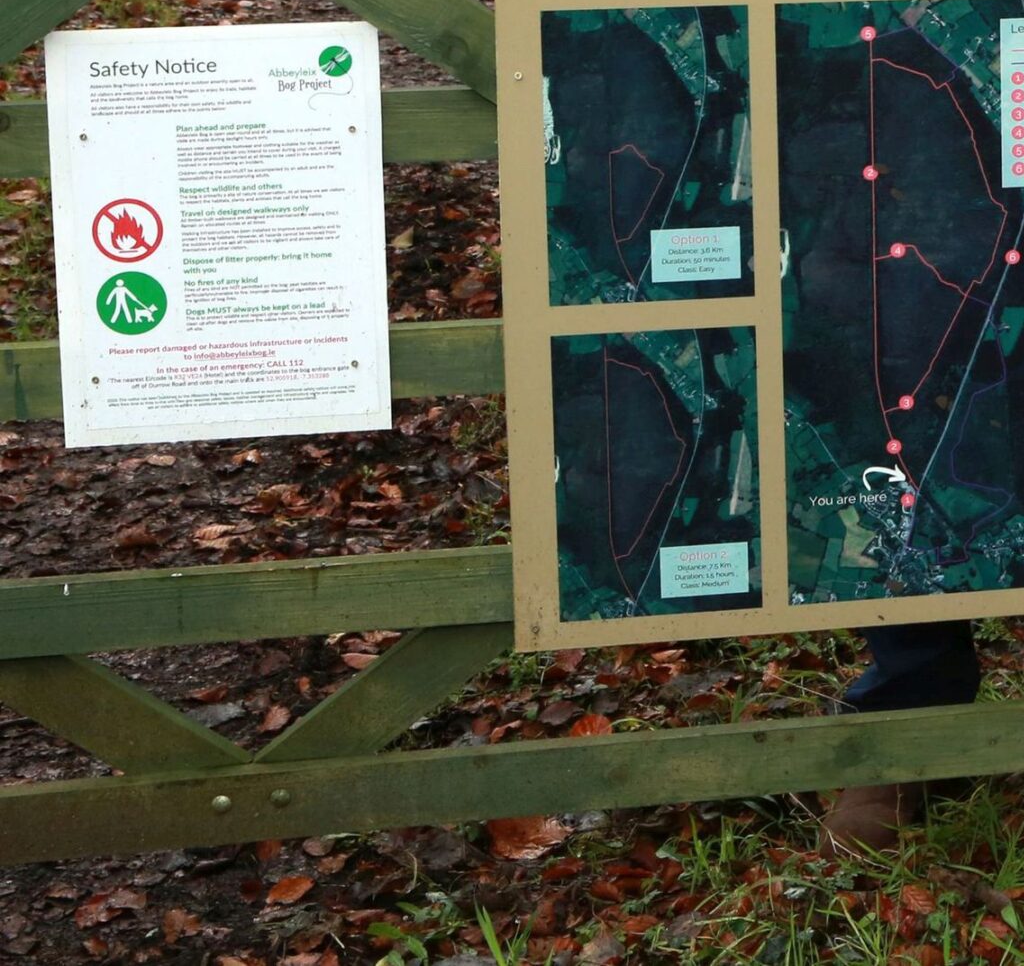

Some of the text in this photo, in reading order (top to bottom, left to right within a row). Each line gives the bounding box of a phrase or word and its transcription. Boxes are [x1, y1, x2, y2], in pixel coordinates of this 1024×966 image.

[89, 58, 217, 79] Safety Notice
[269, 68, 316, 77] Abbeyleix
[278, 79, 331, 92] Bog Project
[217, 208, 252, 216] designed
[671, 235, 710, 247] Option
[135, 346, 160, 354] report
[161, 344, 197, 352] damaged
[249, 339, 302, 347] infrastructure
[266, 360, 287, 368] CALL
[809, 493, 887, 506] You are here
[679, 551, 718, 563] Option
